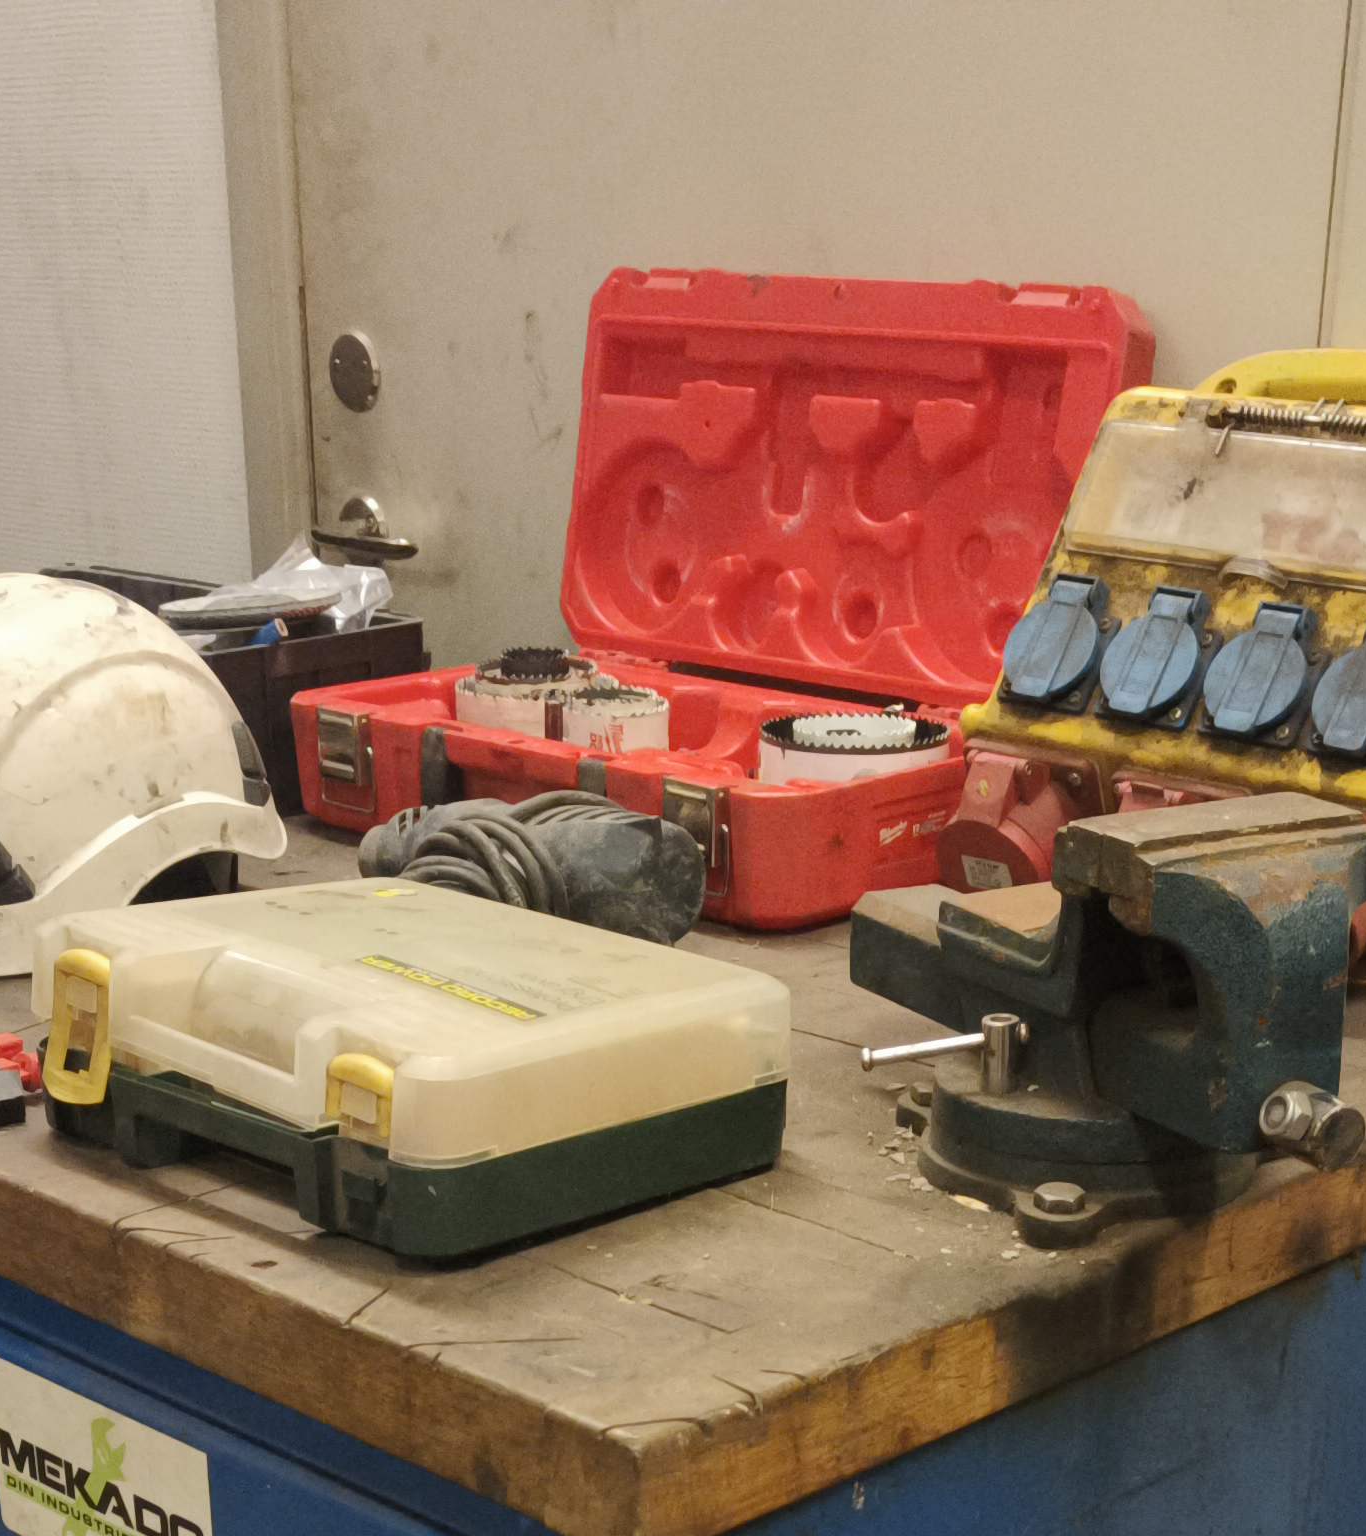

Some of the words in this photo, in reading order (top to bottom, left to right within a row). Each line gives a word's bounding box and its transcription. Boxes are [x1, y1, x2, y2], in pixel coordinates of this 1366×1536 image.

[362, 954, 443, 988] POWER
[440, 983, 537, 1020] RECORD
[6, 1474, 35, 1497] DIN
